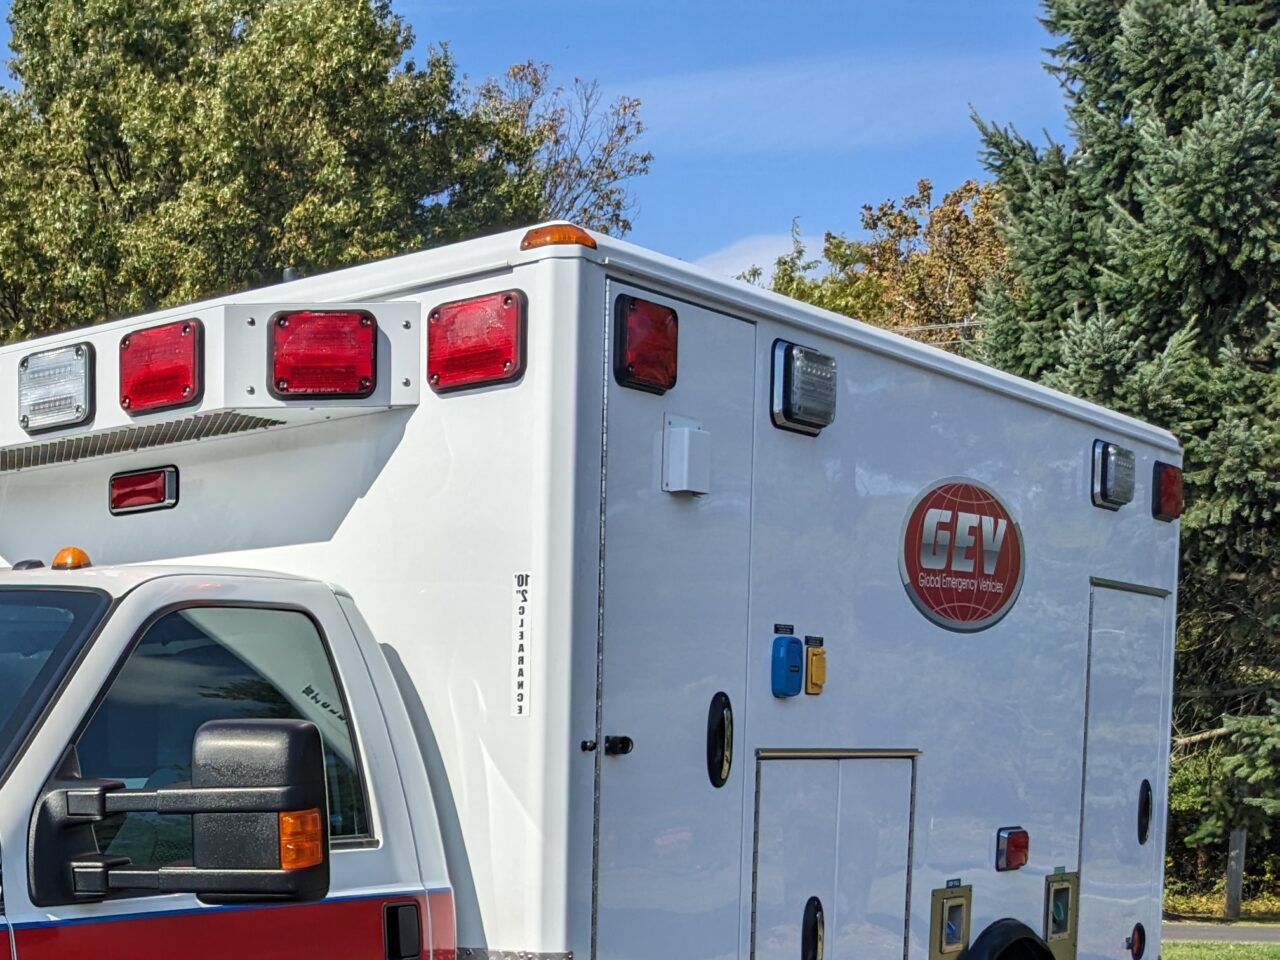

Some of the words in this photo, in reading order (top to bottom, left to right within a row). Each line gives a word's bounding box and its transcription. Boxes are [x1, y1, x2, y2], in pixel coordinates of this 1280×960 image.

[920, 508, 1007, 575] GEV
[919, 572, 942, 588] Global
[942, 573, 978, 593] Emergency
[979, 577, 1004, 593] Vehicles
